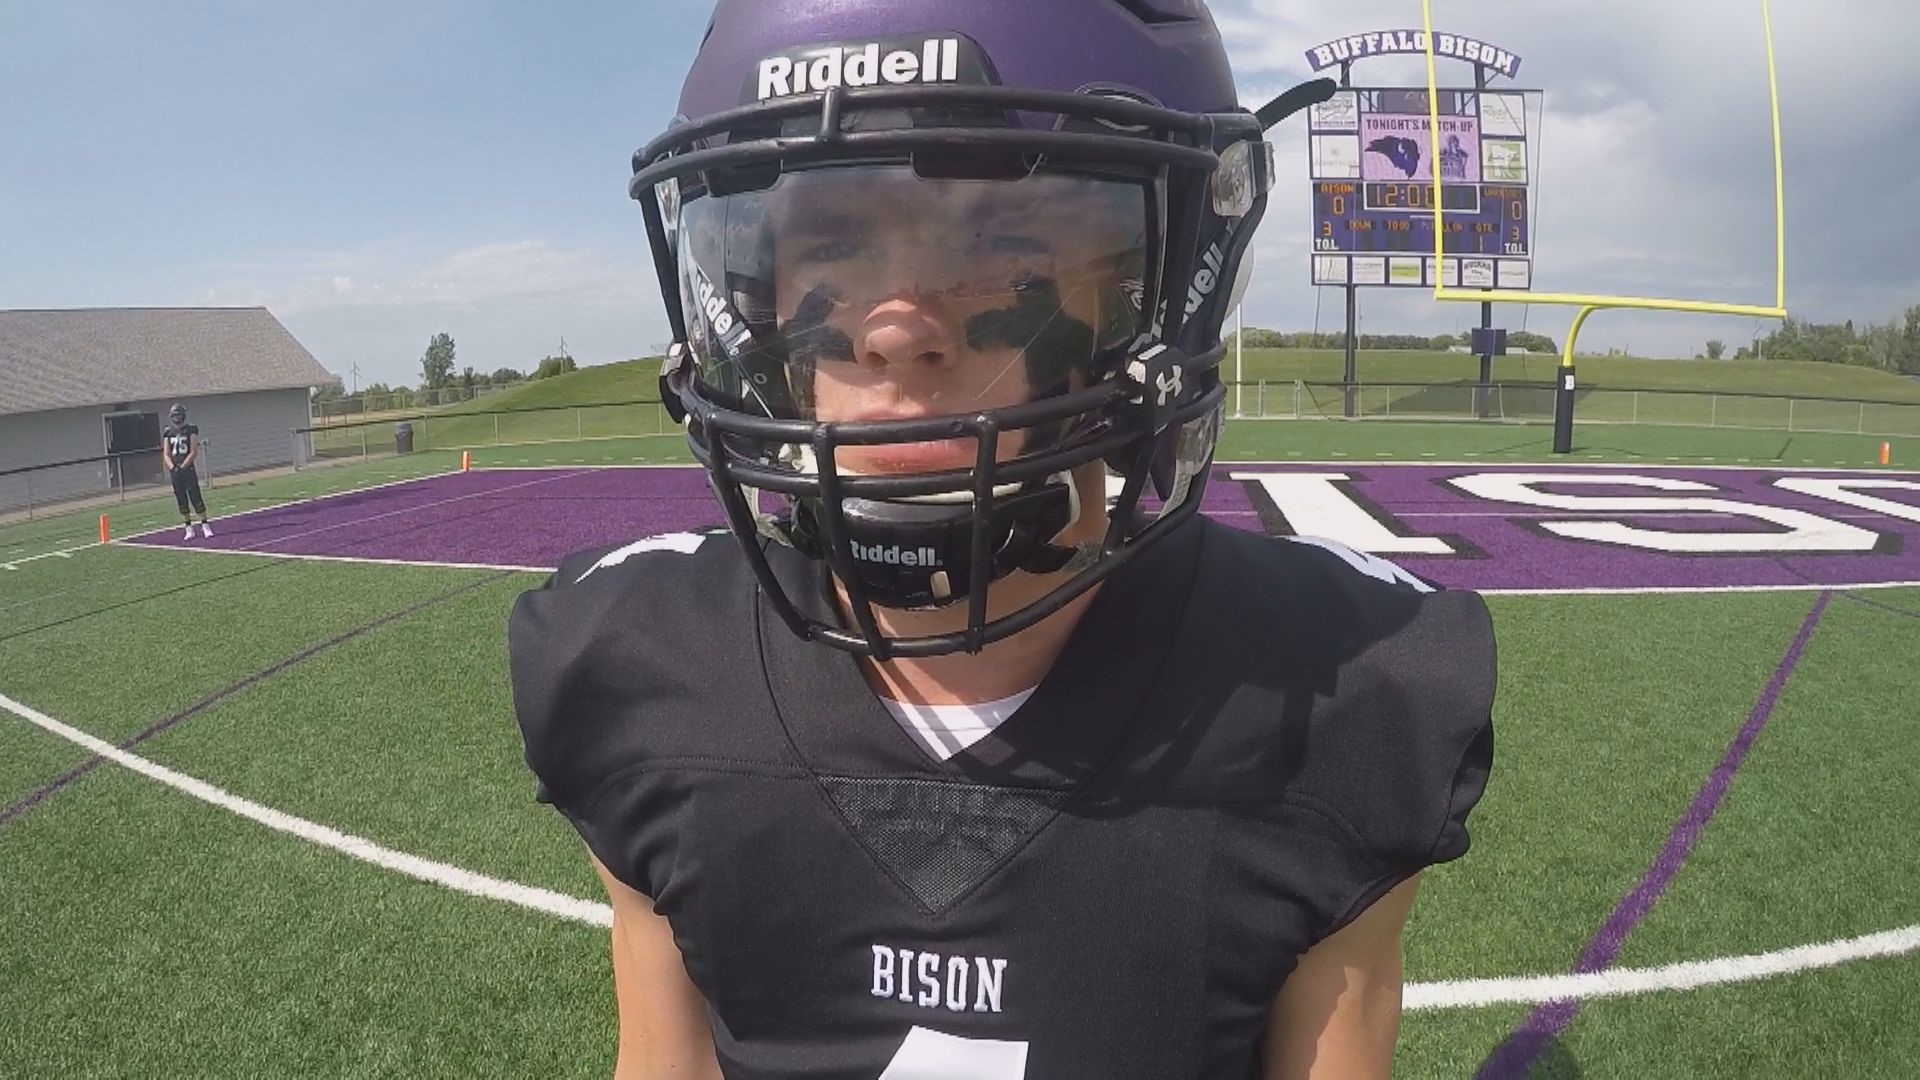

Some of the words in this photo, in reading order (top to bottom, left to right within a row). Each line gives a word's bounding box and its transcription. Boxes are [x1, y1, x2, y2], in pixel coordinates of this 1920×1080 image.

[1314, 31, 1426, 66] BUFFALO
[1438, 33, 1516, 73] BISON
[758, 39, 958, 100] Riddell
[1367, 119, 1420, 130] TONIGHT'S
[1421, 120, 1473, 132] MTCH-UP
[1333, 195, 1344, 215] 0
[1511, 200, 1522, 220] 0
[1323, 220, 1332, 237] 3
[1511, 225, 1520, 241] 3
[170, 435, 188, 456] 75
[870, 944, 1008, 1013] BISON
